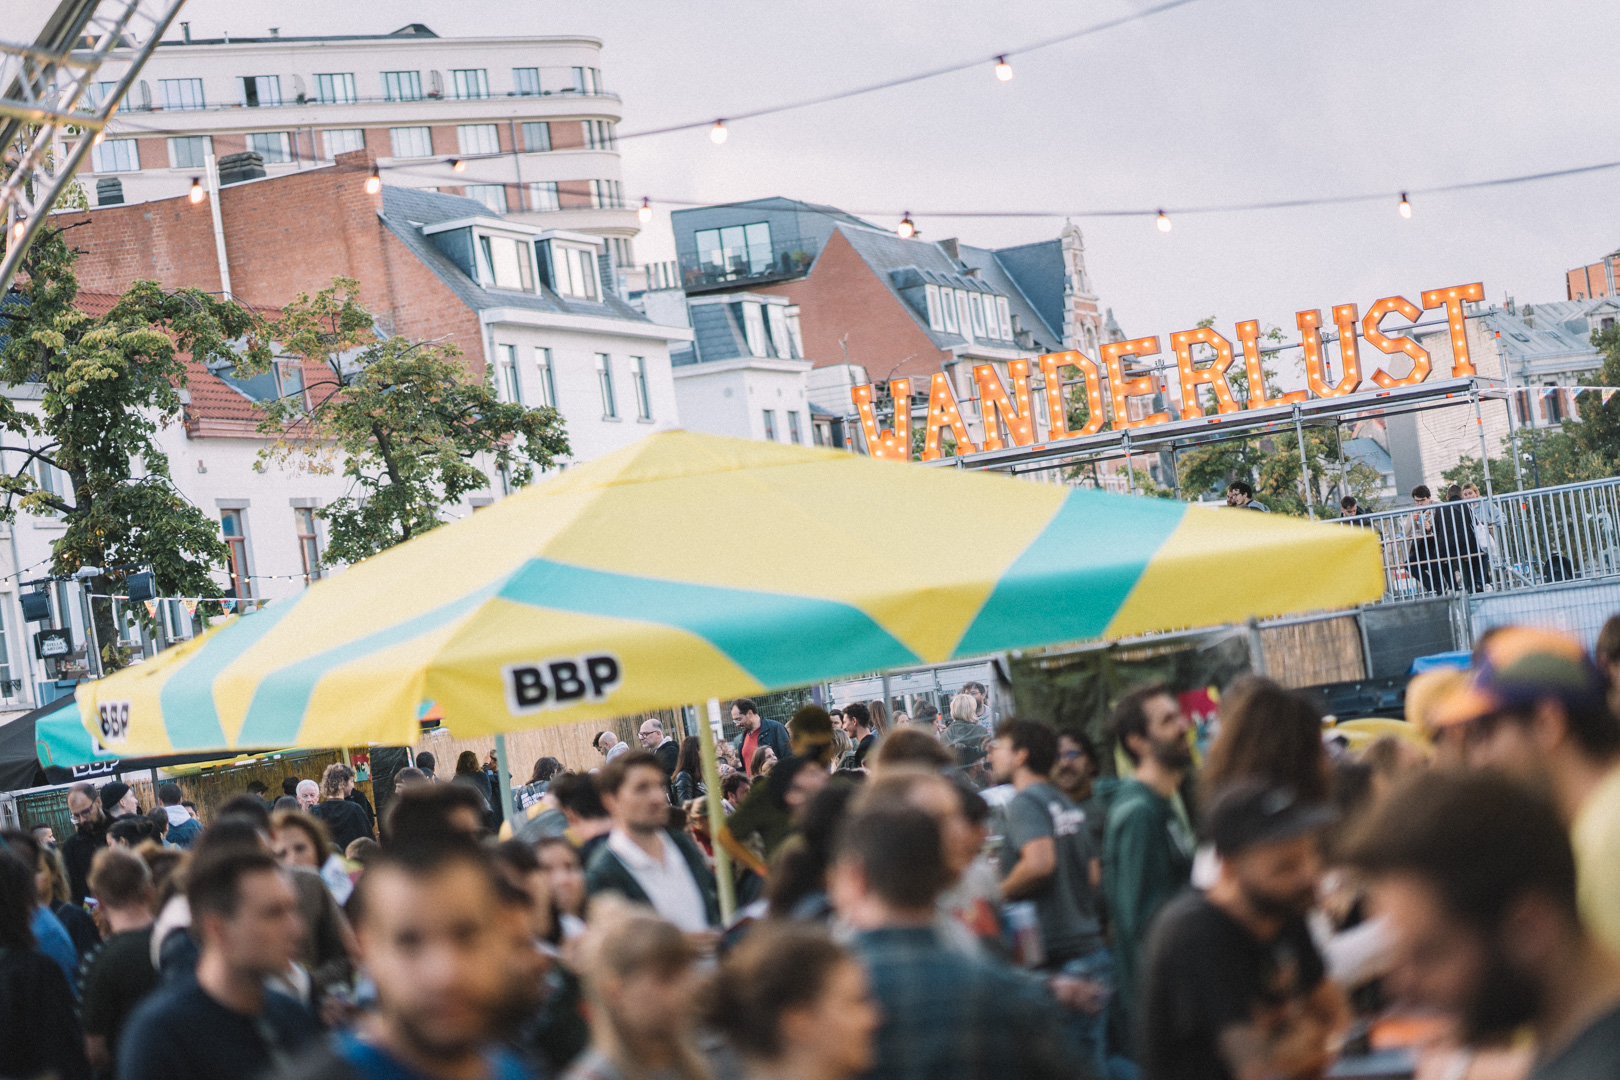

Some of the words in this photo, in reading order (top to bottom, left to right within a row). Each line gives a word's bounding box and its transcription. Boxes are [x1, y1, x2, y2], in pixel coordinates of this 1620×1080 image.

[851, 282, 1485, 463] WANDERLUST
[512, 656, 619, 707] BBP
[100, 704, 129, 737] BBP
